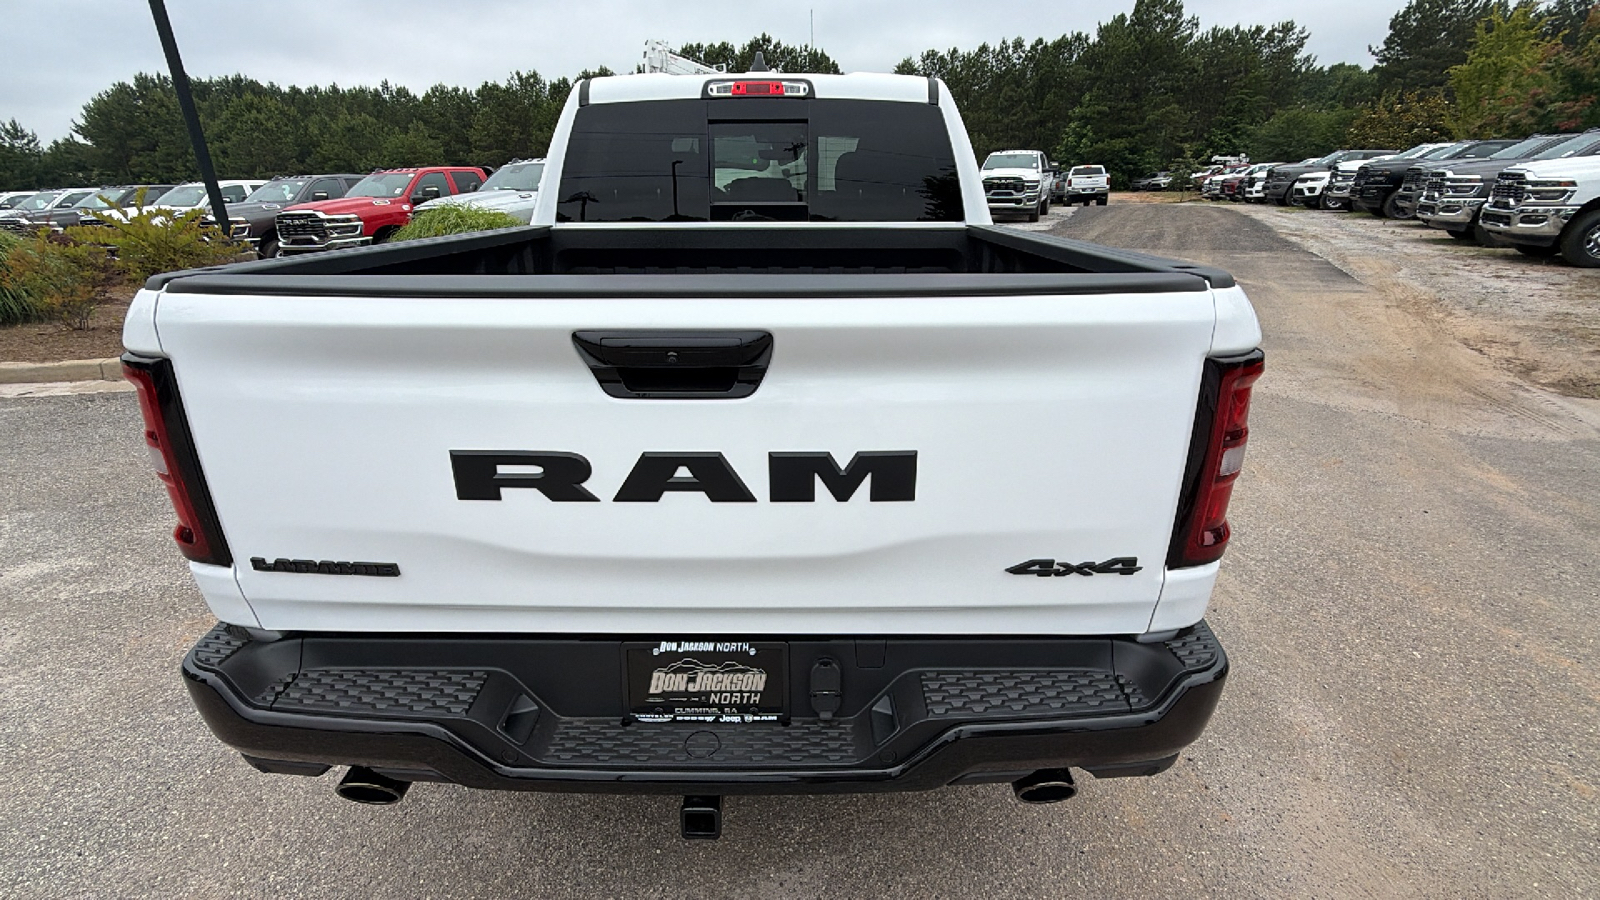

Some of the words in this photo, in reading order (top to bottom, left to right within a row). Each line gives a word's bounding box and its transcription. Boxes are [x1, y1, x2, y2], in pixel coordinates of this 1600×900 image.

[449, 450, 918, 502] RAM
[250, 556, 402, 578] LARAMIE
[716, 641, 750, 653] NORTH
[648, 671, 688, 694] DON
[687, 672, 768, 692] JACKSON
[709, 692, 761, 704] NORTH
[719, 714, 742, 723] Jeep
